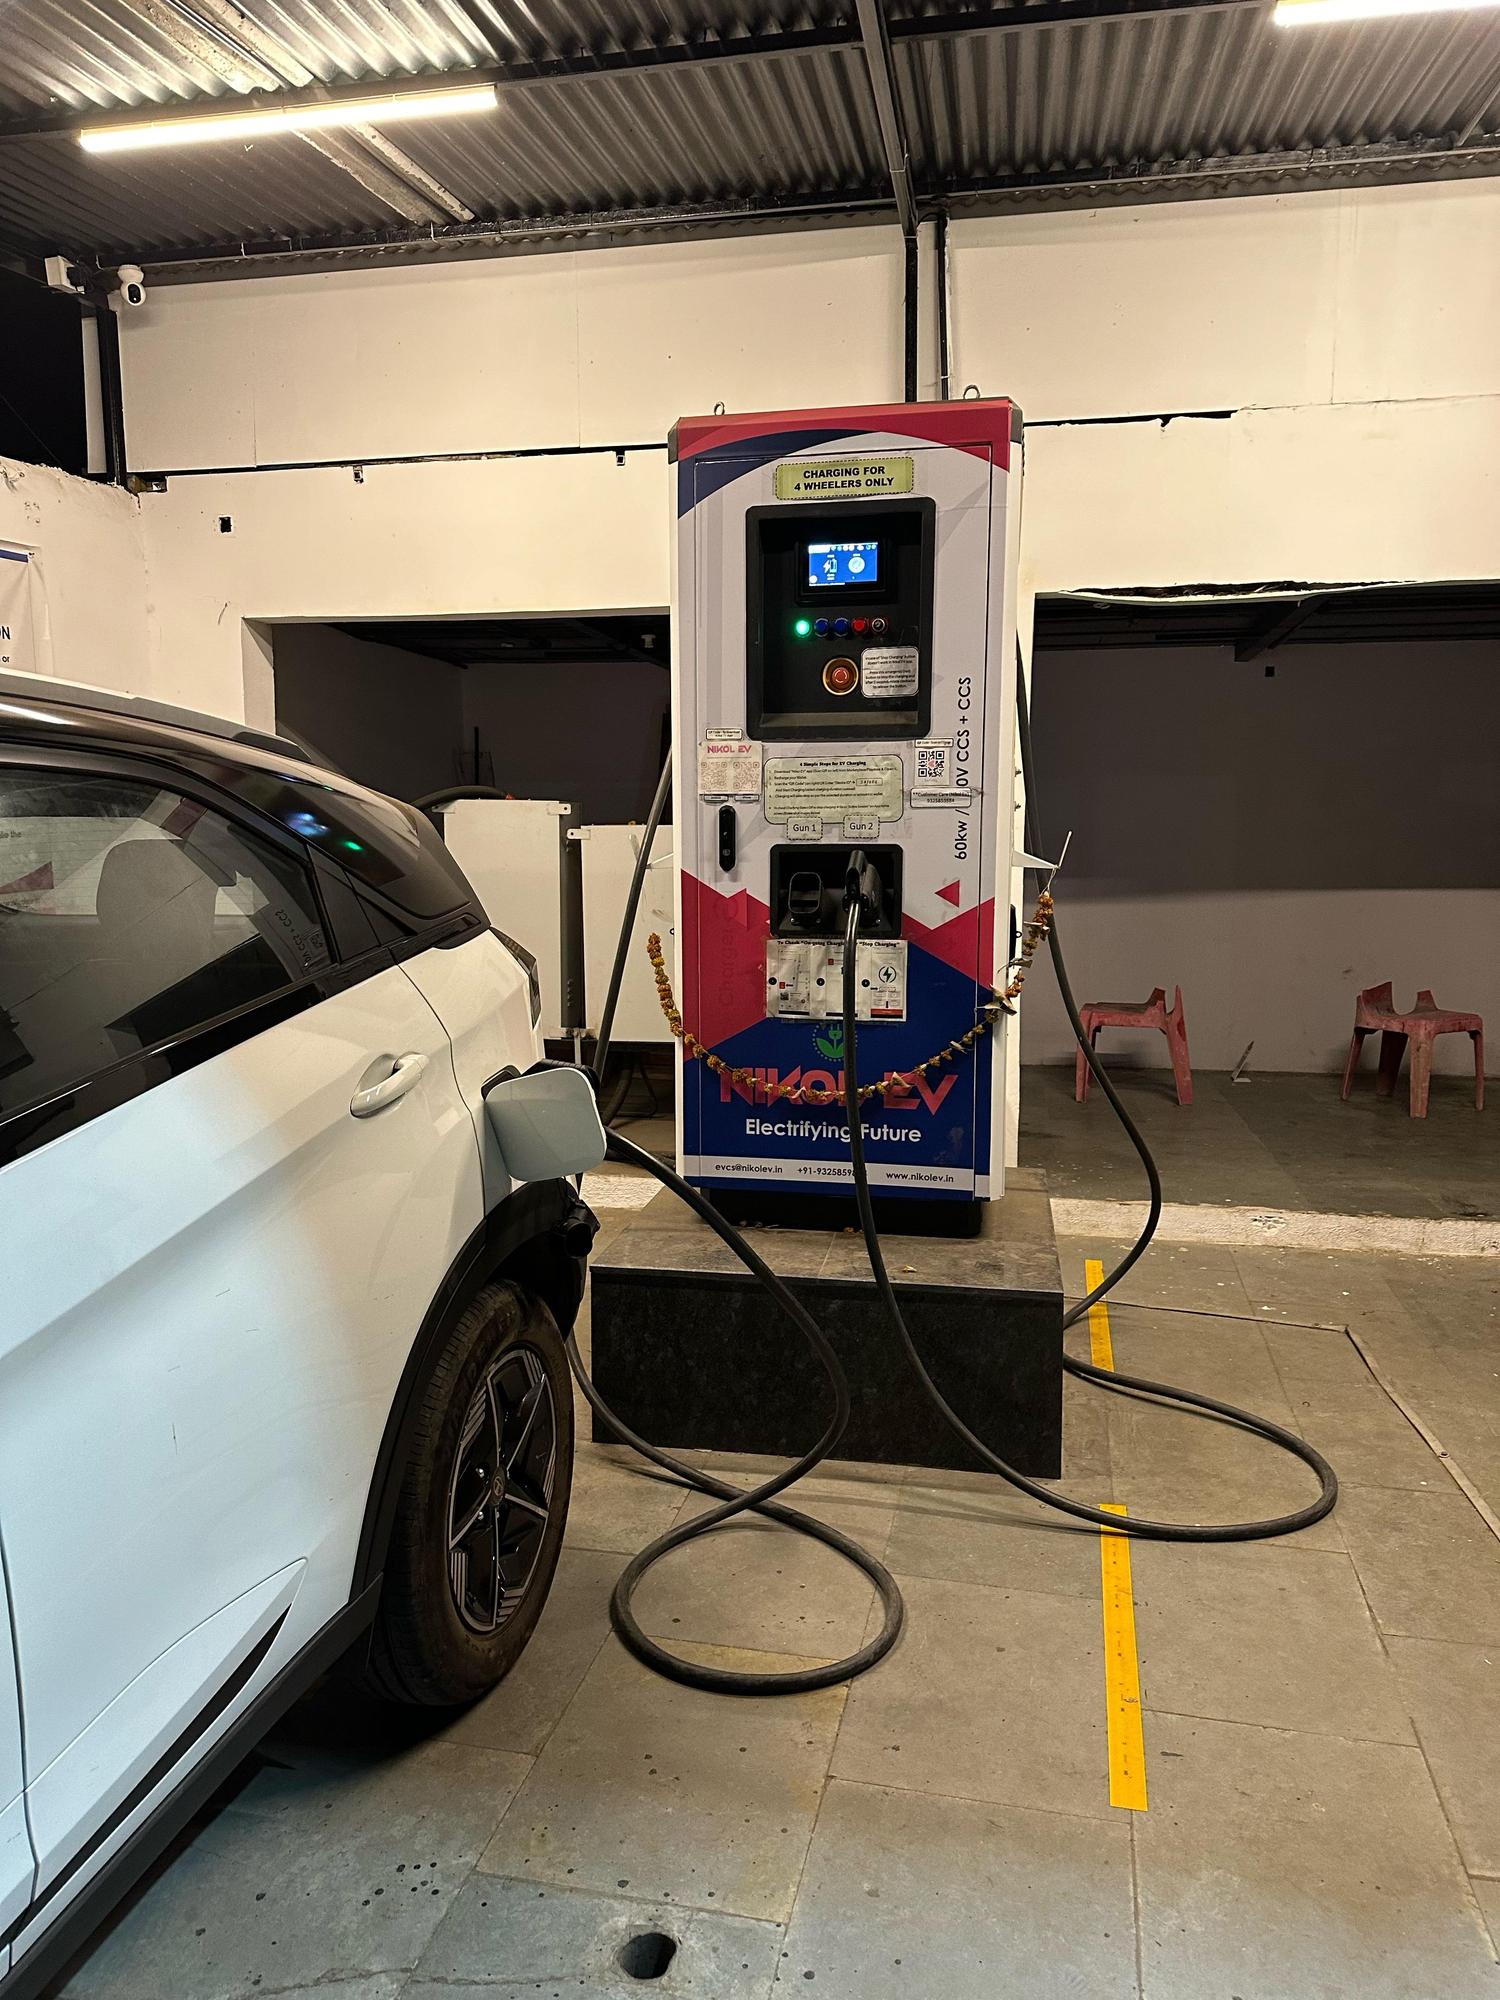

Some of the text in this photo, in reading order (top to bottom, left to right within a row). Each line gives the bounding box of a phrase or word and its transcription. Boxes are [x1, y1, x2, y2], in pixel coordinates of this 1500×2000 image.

[803, 466, 886, 479] CHARGING FOR
[794, 477, 895, 491] 4 WHEELERS ONLY
[0, 625, 10, 640] N
[958, 677, 970, 710] CCS
[959, 716, 968, 724] +
[707, 745, 752, 754] NIKOL EV
[957, 730, 970, 762] CCS
[954, 820, 968, 860] 60kw
[884, 1072, 959, 1116] EV
[746, 1118, 922, 1142] Electrifying Future
[715, 1164, 954, 1183] evcs@nikolev.in +91-9325859 www.nikolev.in
